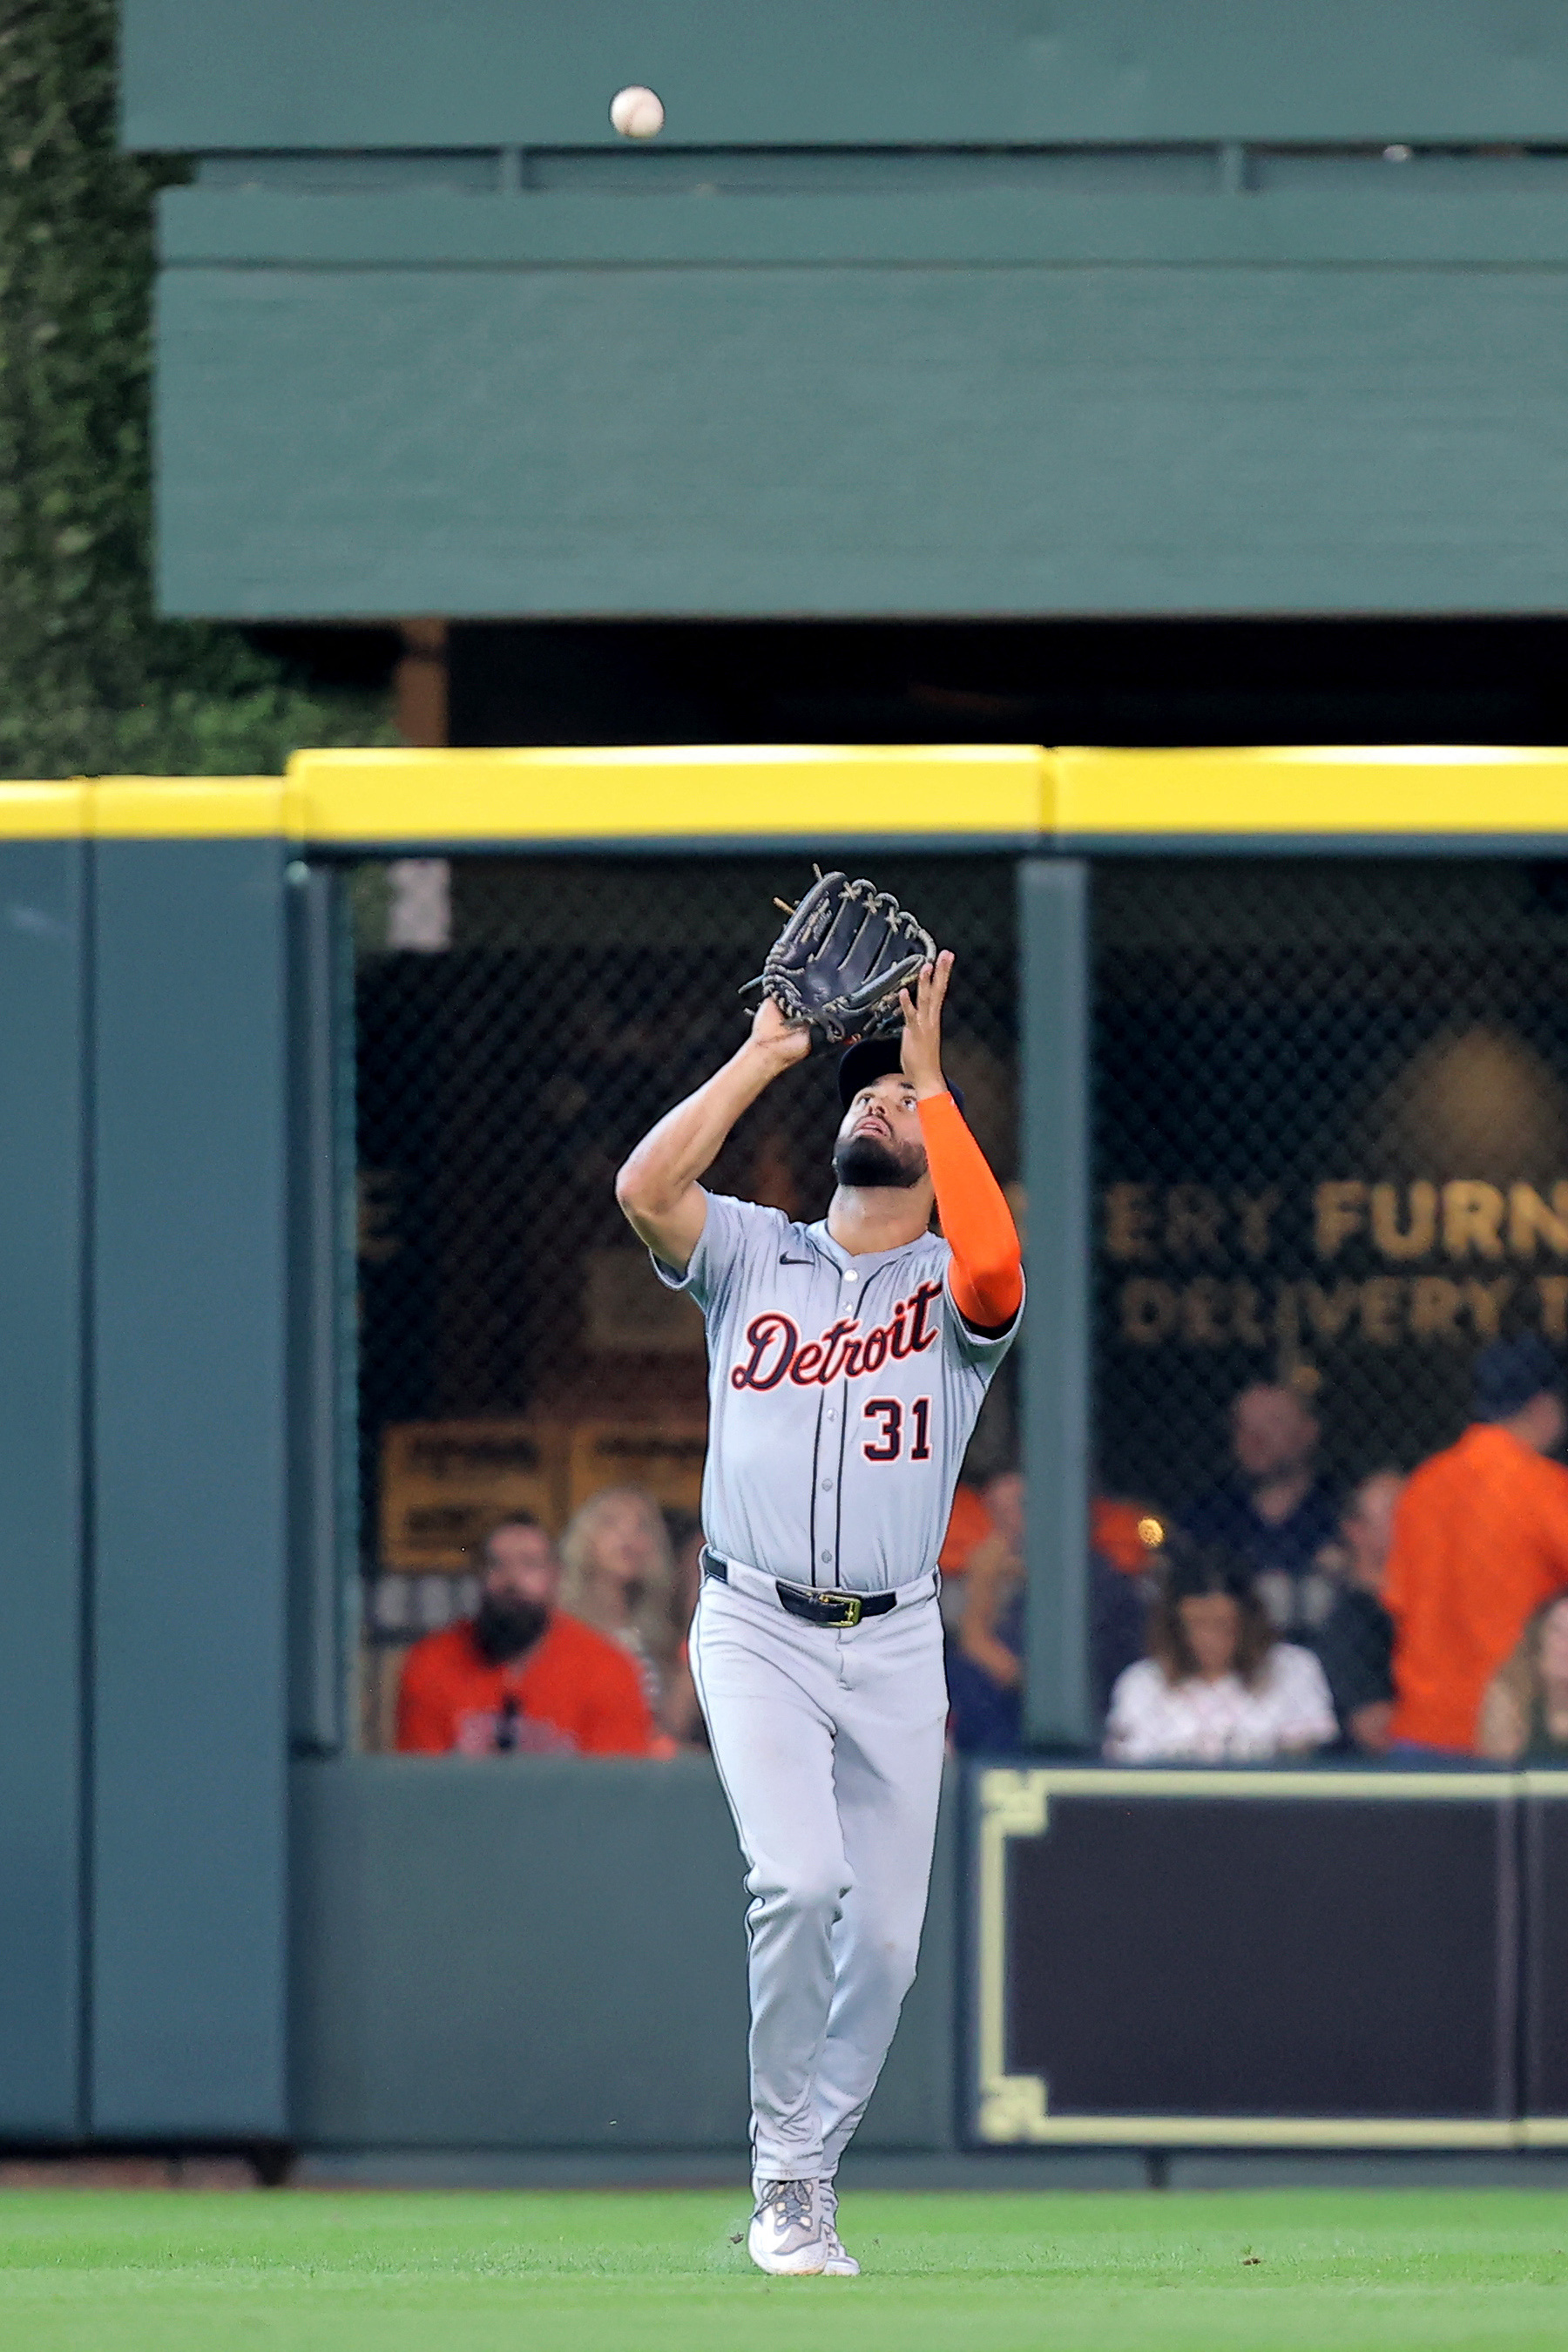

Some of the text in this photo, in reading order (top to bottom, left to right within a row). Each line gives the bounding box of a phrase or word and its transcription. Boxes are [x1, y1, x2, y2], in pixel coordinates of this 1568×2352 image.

[1104, 1179, 1282, 1262] ERY
[731, 1281, 943, 1392] Detroit
[862, 1395, 931, 1463] 31
